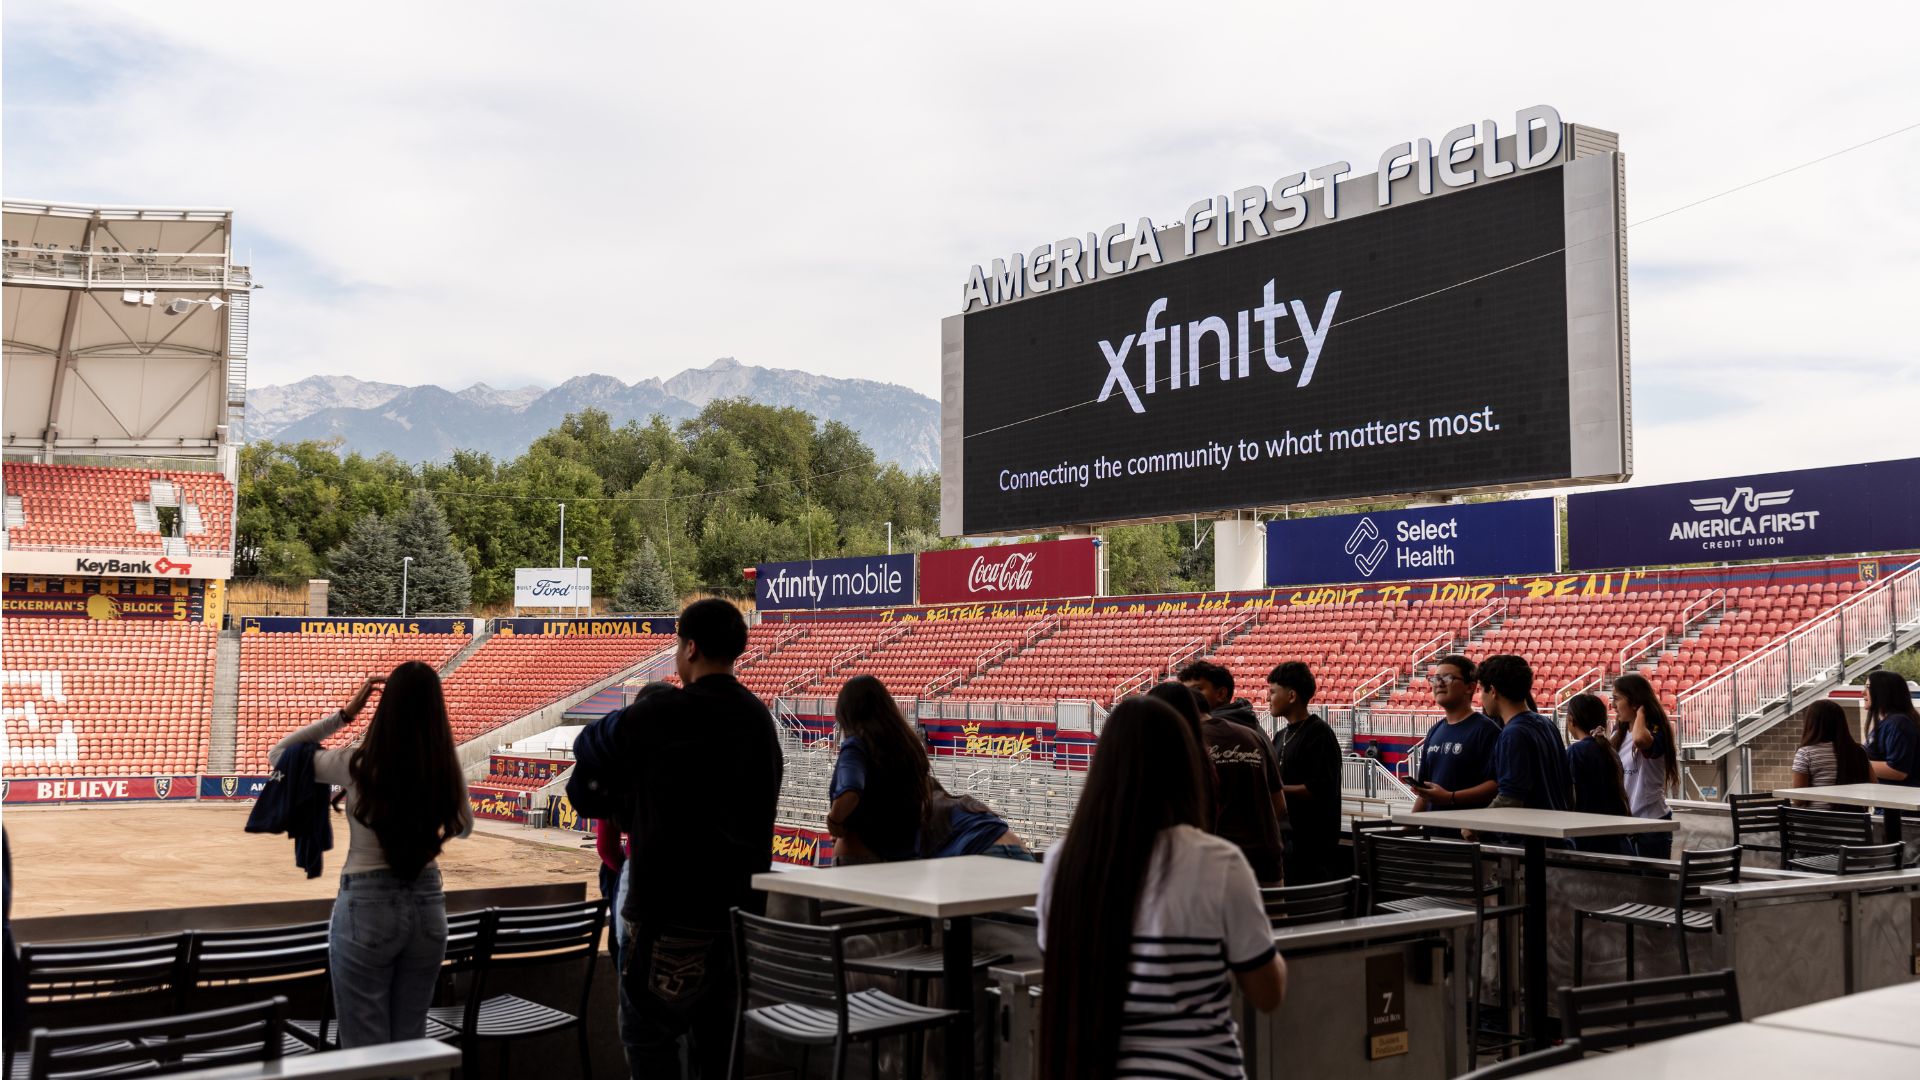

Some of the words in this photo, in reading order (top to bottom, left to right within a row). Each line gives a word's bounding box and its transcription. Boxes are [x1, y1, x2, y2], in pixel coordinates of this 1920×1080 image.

[962, 217, 1163, 312] AMERICA
[1184, 160, 1351, 256] FIRST
[1376, 104, 1563, 207] FIELD
[1097, 278, 1342, 413] xfinity
[999, 461, 1089, 491] Connecting
[1094, 456, 1122, 480] the
[1127, 441, 1233, 475] community
[1238, 438, 1259, 462] to
[1266, 429, 1323, 459] what
[1329, 420, 1421, 451] matters
[1429, 406, 1500, 439] most.
[1396, 517, 1458, 542] Select
[1669, 516, 1757, 541] AMERICA
[1759, 511, 1820, 534] FIRST
[1702, 539, 1743, 550] CREDIT
[1748, 536, 1784, 547] UNION
[1396, 544, 1455, 568] Health
[76, 558, 152, 577] KeyBank
[532, 579, 571, 597] Ford
[766, 568, 828, 604] xfinity
[832, 563, 902, 596] mobile
[123, 602, 163, 613] BLOCK
[173, 601, 187, 620] 5
[1056, 598, 1095, 616] stand
[1243, 590, 1276, 609] and
[301, 621, 350, 634] UTAH
[352, 622, 420, 635] ROYALS
[543, 622, 591, 635] UTAH
[592, 621, 652, 635] ROYALS
[965, 731, 1034, 755] BELIEVE
[37, 780, 129, 799] BELIEVE
[1382, 992, 1393, 1013] 7
